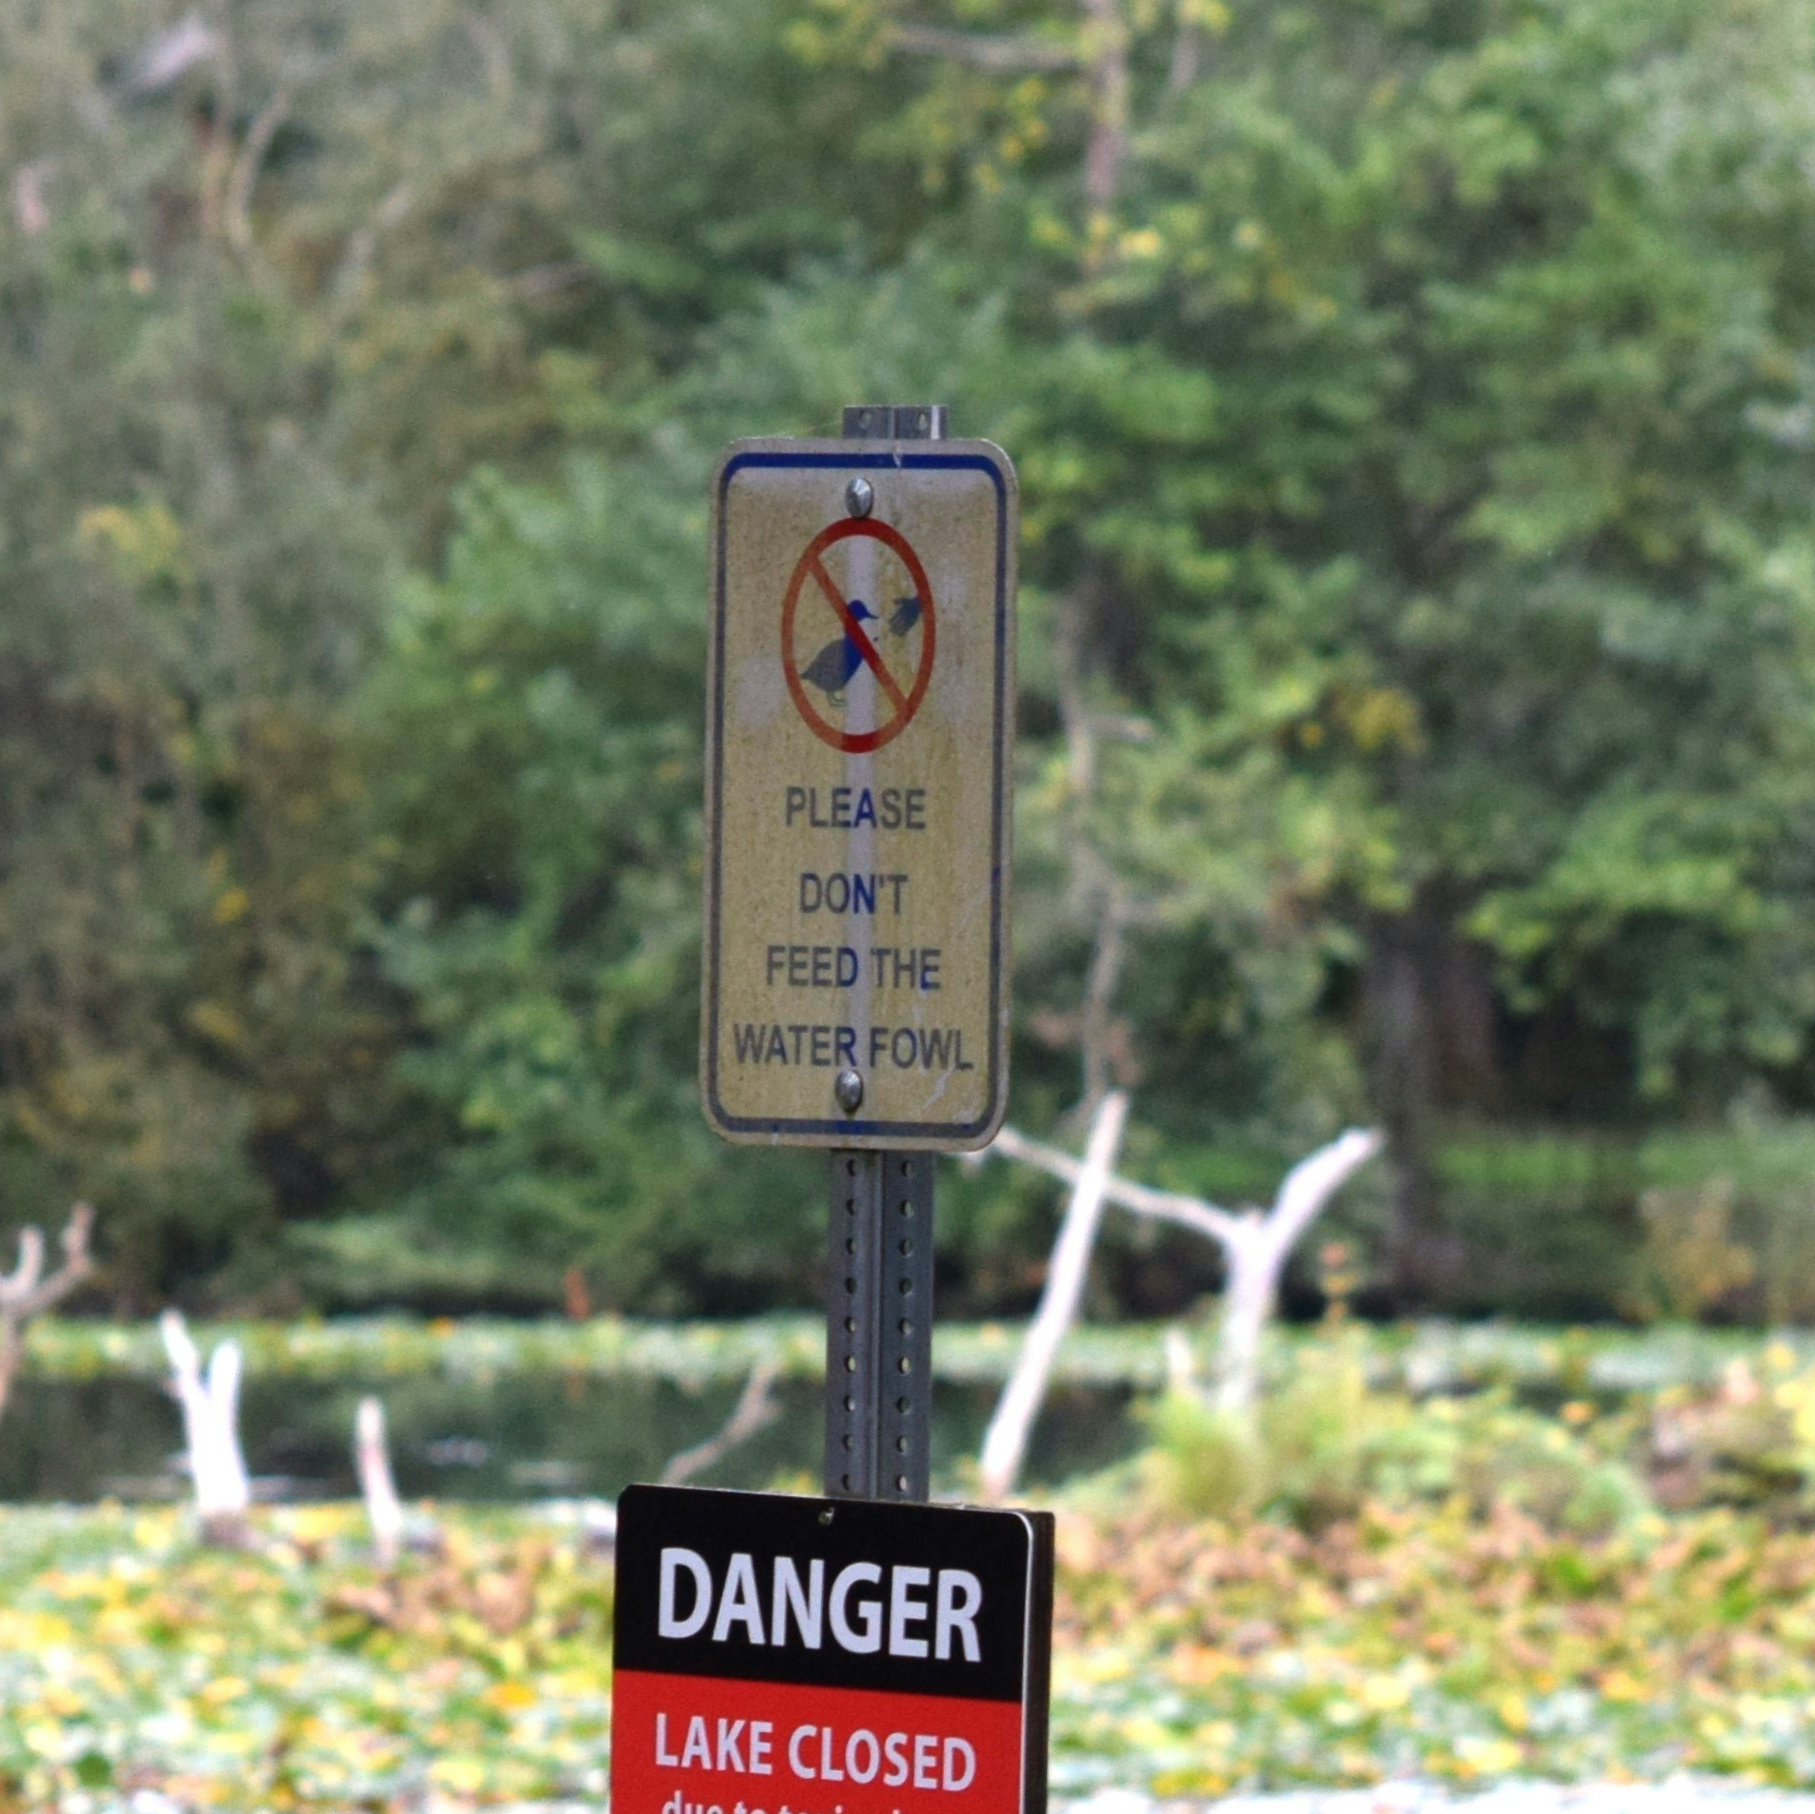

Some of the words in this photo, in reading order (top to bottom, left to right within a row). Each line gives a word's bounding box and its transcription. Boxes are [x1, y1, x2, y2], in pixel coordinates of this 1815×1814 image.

[786, 787, 926, 829] PLEASE
[800, 873, 908, 915] DON'T
[766, 945, 859, 988] FEED
[871, 948, 942, 990] THE
[734, 1023, 856, 1067] WATER
[869, 1026, 975, 1071] FOWL
[658, 1546, 983, 1662] DANGER
[656, 1713, 772, 1775] LAKE
[788, 1724, 976, 1792] CLOSED
